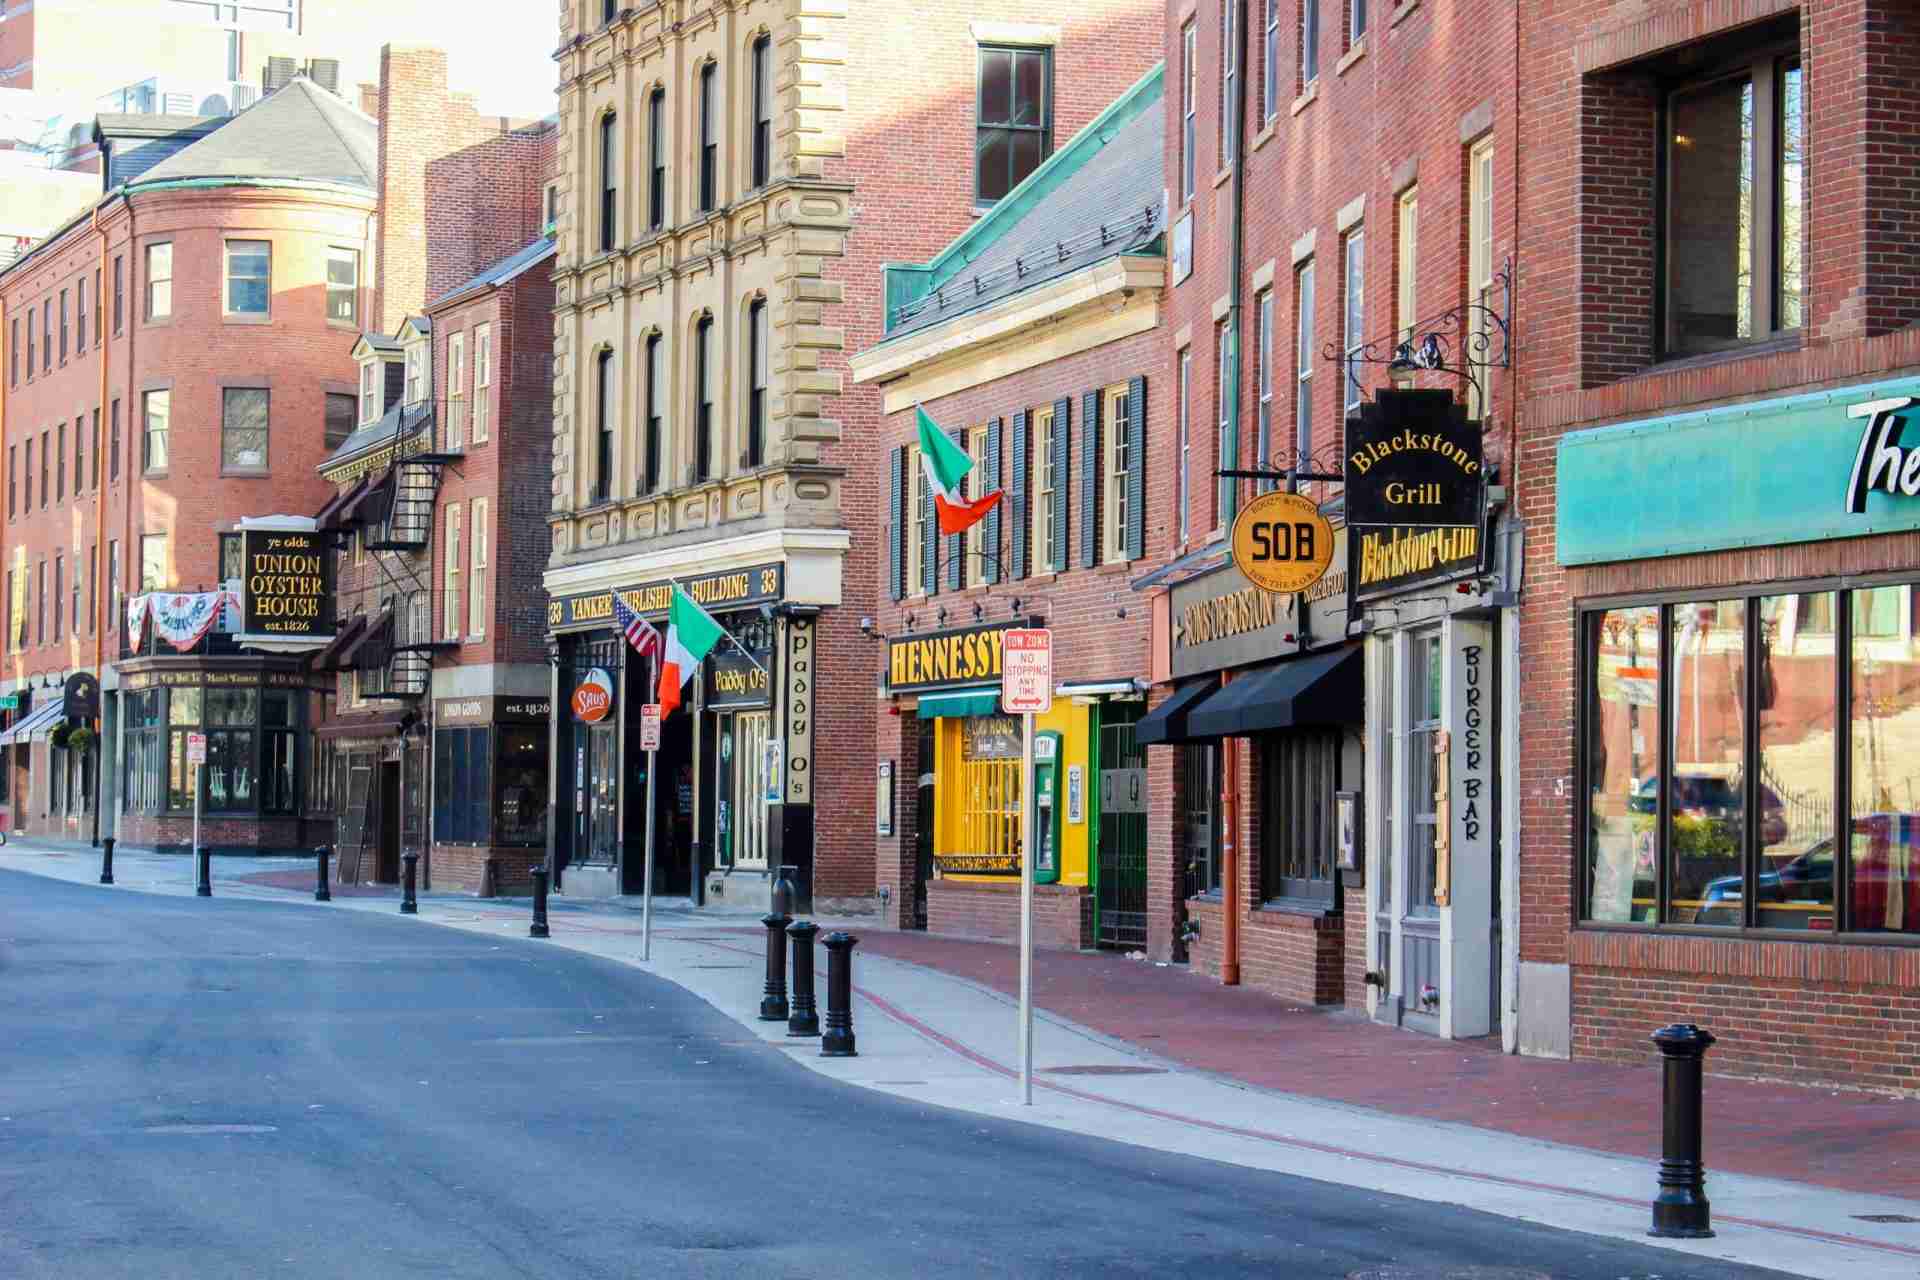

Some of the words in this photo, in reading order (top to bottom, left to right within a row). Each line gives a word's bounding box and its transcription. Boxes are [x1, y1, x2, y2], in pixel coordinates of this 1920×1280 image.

[1350, 428, 1479, 475] Blackstone
[1385, 482, 1442, 504] Grill
[284, 536, 310, 549] olde
[1252, 522, 1315, 561] SOB
[254, 553, 321, 575] UNION
[1360, 527, 1436, 585] Blackstone
[250, 575, 325, 596] OYSTER
[549, 601, 562, 625] 33
[571, 594, 613, 621] YANKEE
[691, 573, 749, 604] BUILDING
[761, 568, 777, 594] 33
[255, 596, 319, 617] HOUSE
[1008, 635, 1024, 649] TOW
[1025, 633, 1049, 649] ZONE
[1020, 653, 1034, 664] NO
[1007, 665, 1048, 675] STOPPING
[715, 670, 747, 695] Paddy
[1018, 678, 1035, 686] ANY
[1018, 687, 1034, 696] TIME
[1462, 645, 1482, 771] BURGER
[1462, 778, 1482, 841] BAR
